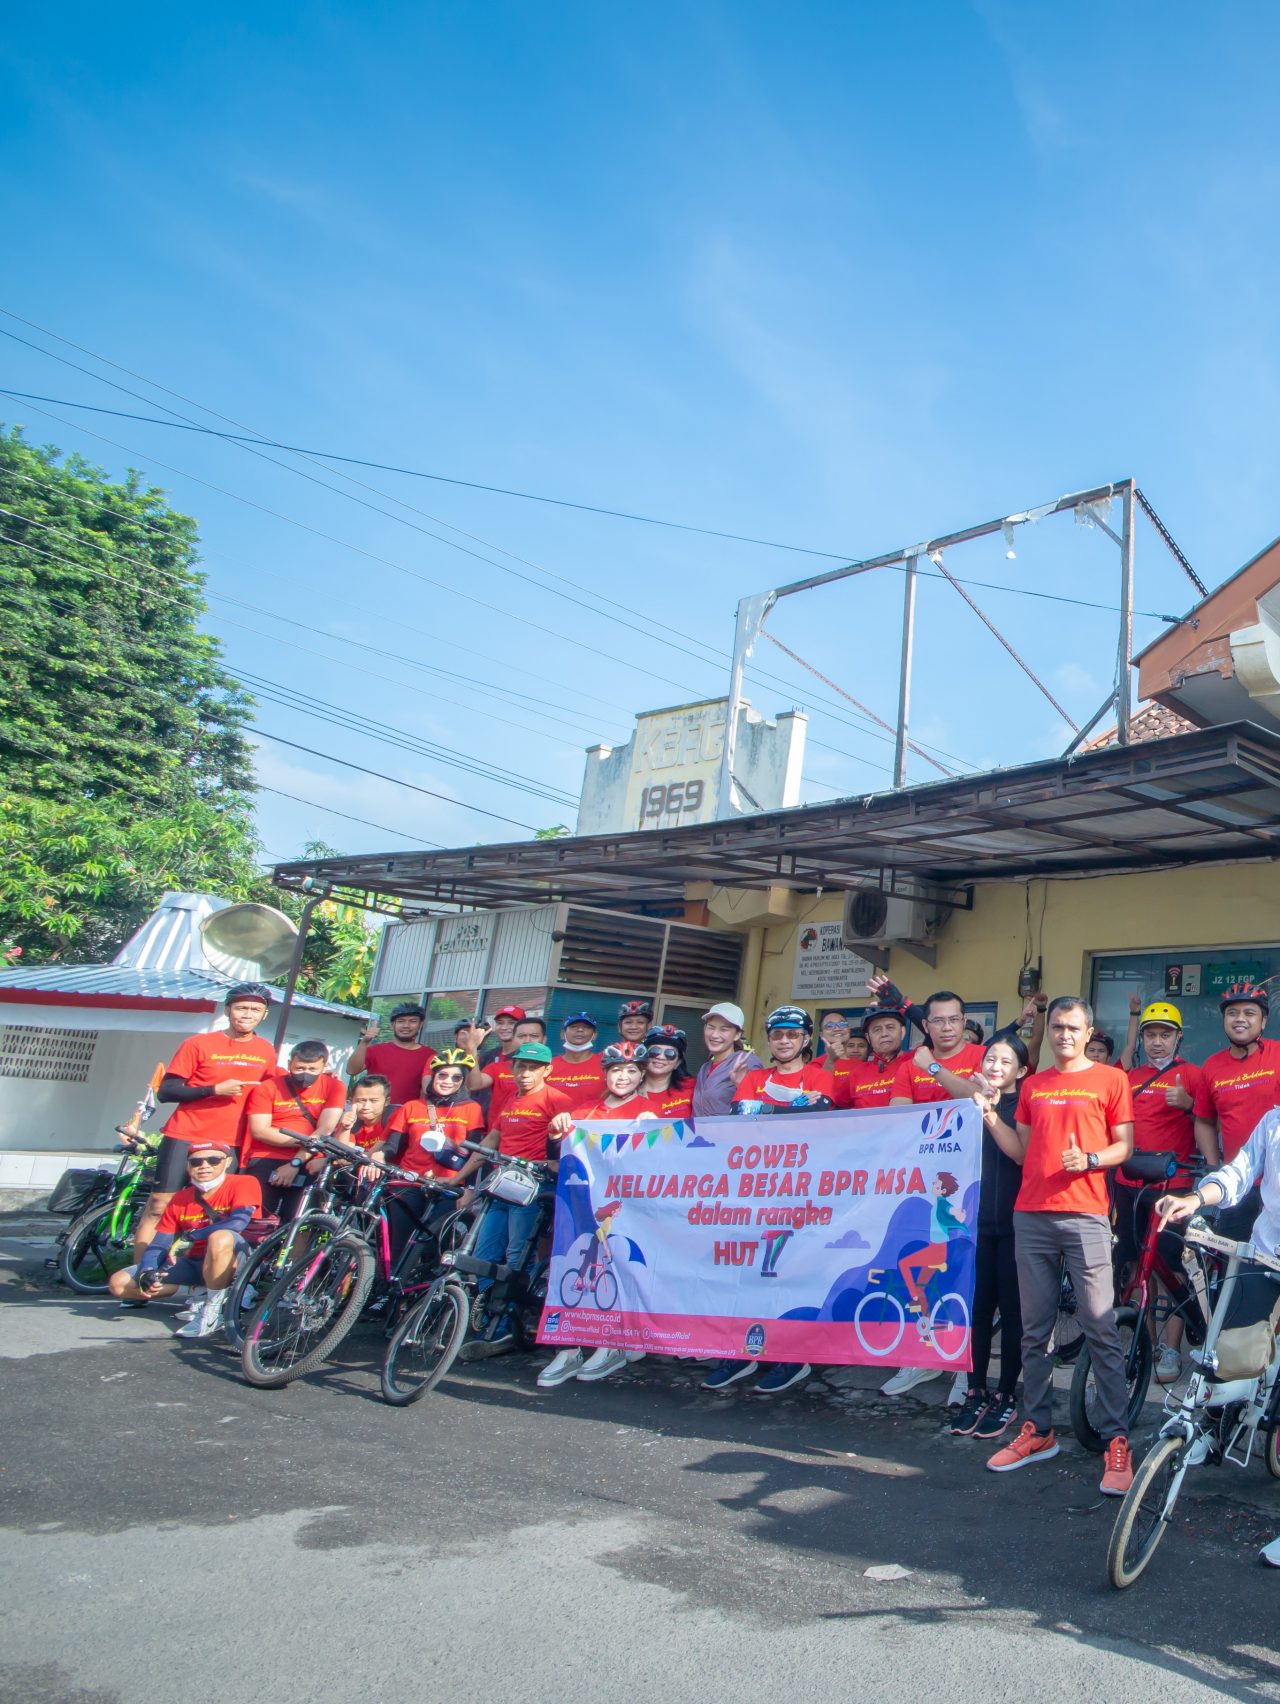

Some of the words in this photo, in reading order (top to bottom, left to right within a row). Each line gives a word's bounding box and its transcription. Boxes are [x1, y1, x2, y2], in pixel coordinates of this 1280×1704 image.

[640, 779, 706, 819] 1969
[727, 1143, 809, 1169] GOWES
[919, 1144, 935, 1154] BPR
[938, 1142, 962, 1153] MSA
[604, 1173, 729, 1198] KELUARGA
[738, 1171, 812, 1197] BESAR
[818, 1170, 868, 1196] BPR
[874, 1167, 927, 1195] MSA
[687, 1201, 752, 1226] dalam
[756, 1200, 833, 1229] rangka
[713, 1241, 759, 1266] HUT
[748, 1335, 764, 1345] BPR
